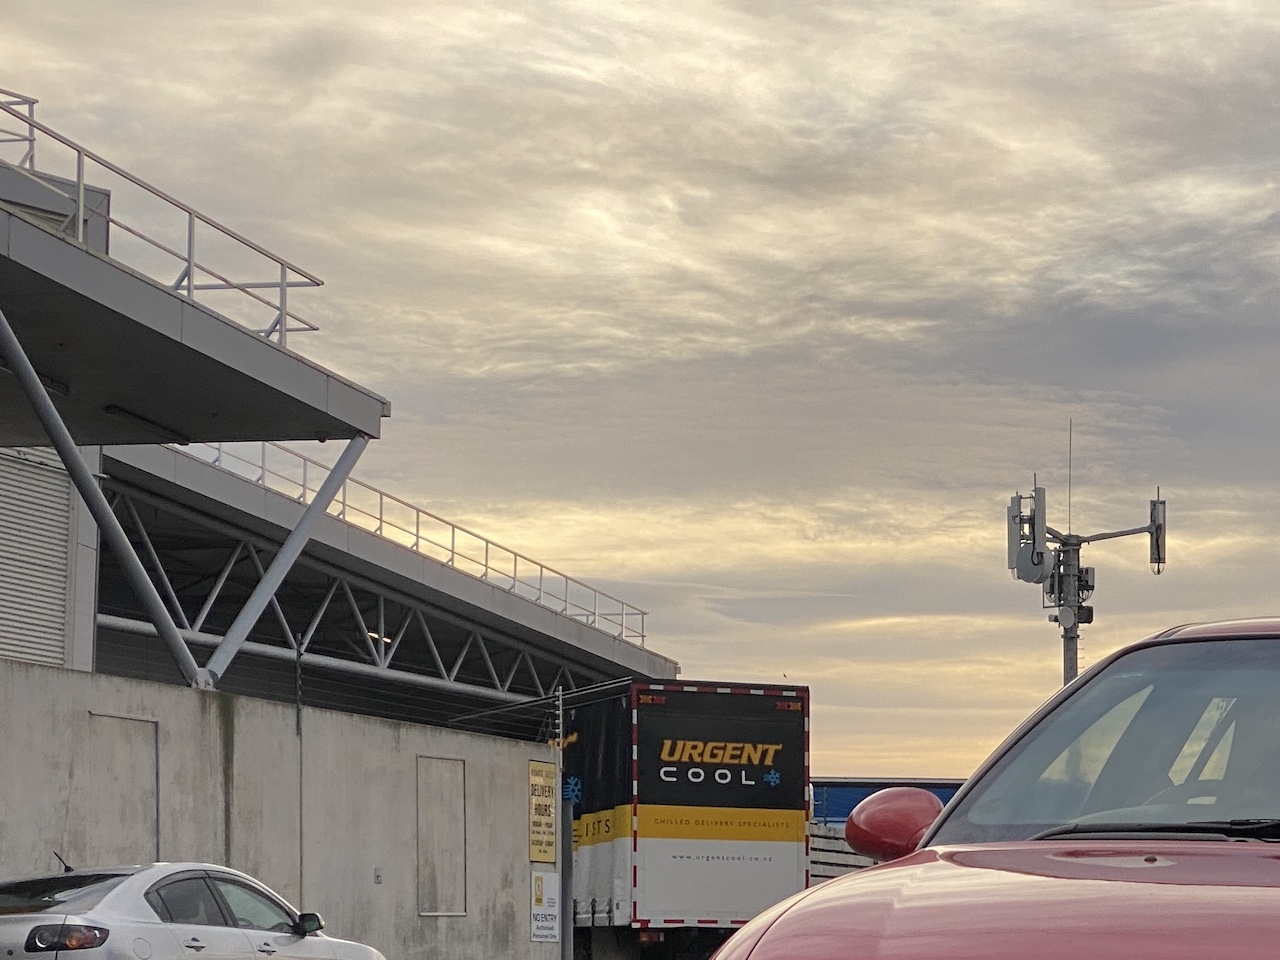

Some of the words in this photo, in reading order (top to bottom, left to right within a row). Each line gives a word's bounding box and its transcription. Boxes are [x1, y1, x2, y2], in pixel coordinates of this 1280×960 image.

[660, 739, 783, 766] URGENT
[660, 766, 756, 785] COOL
[531, 784, 554, 798] DELIVERY
[654, 818, 690, 826] CHILLED
[738, 821, 790, 829] SPECIALISTS
[672, 854, 773, 862] www.urgentcool.co.nz
[533, 914, 540, 922] NO
[541, 914, 557, 922] ENTRY
